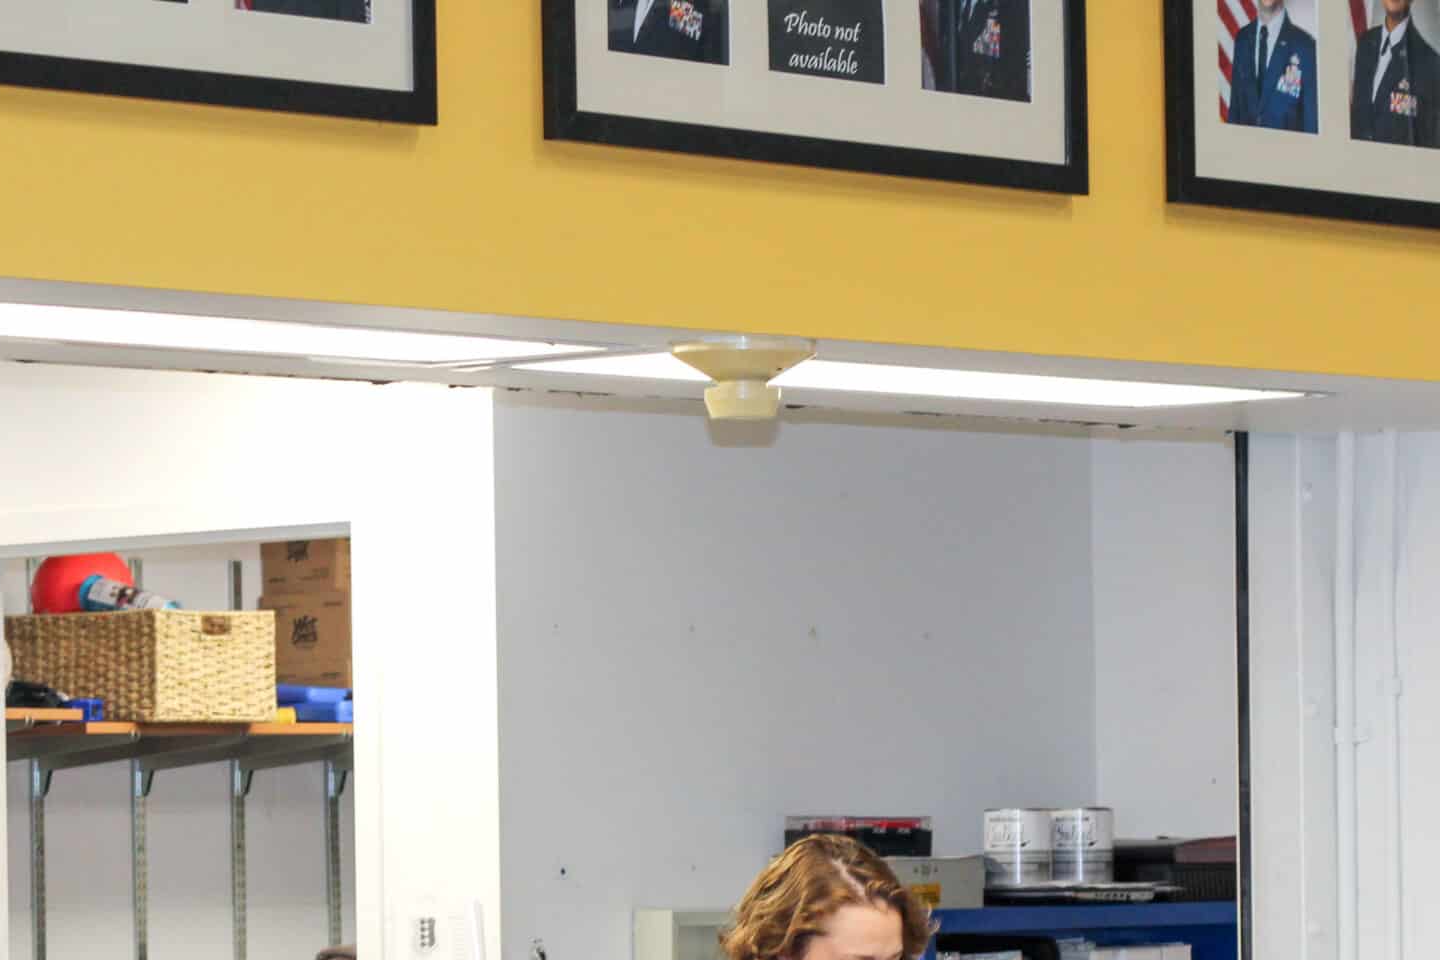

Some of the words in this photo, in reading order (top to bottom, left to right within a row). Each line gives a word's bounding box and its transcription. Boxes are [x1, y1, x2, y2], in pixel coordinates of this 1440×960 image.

[783, 9, 831, 38] Photo
[834, 21, 861, 43] not
[788, 46, 859, 75] available
